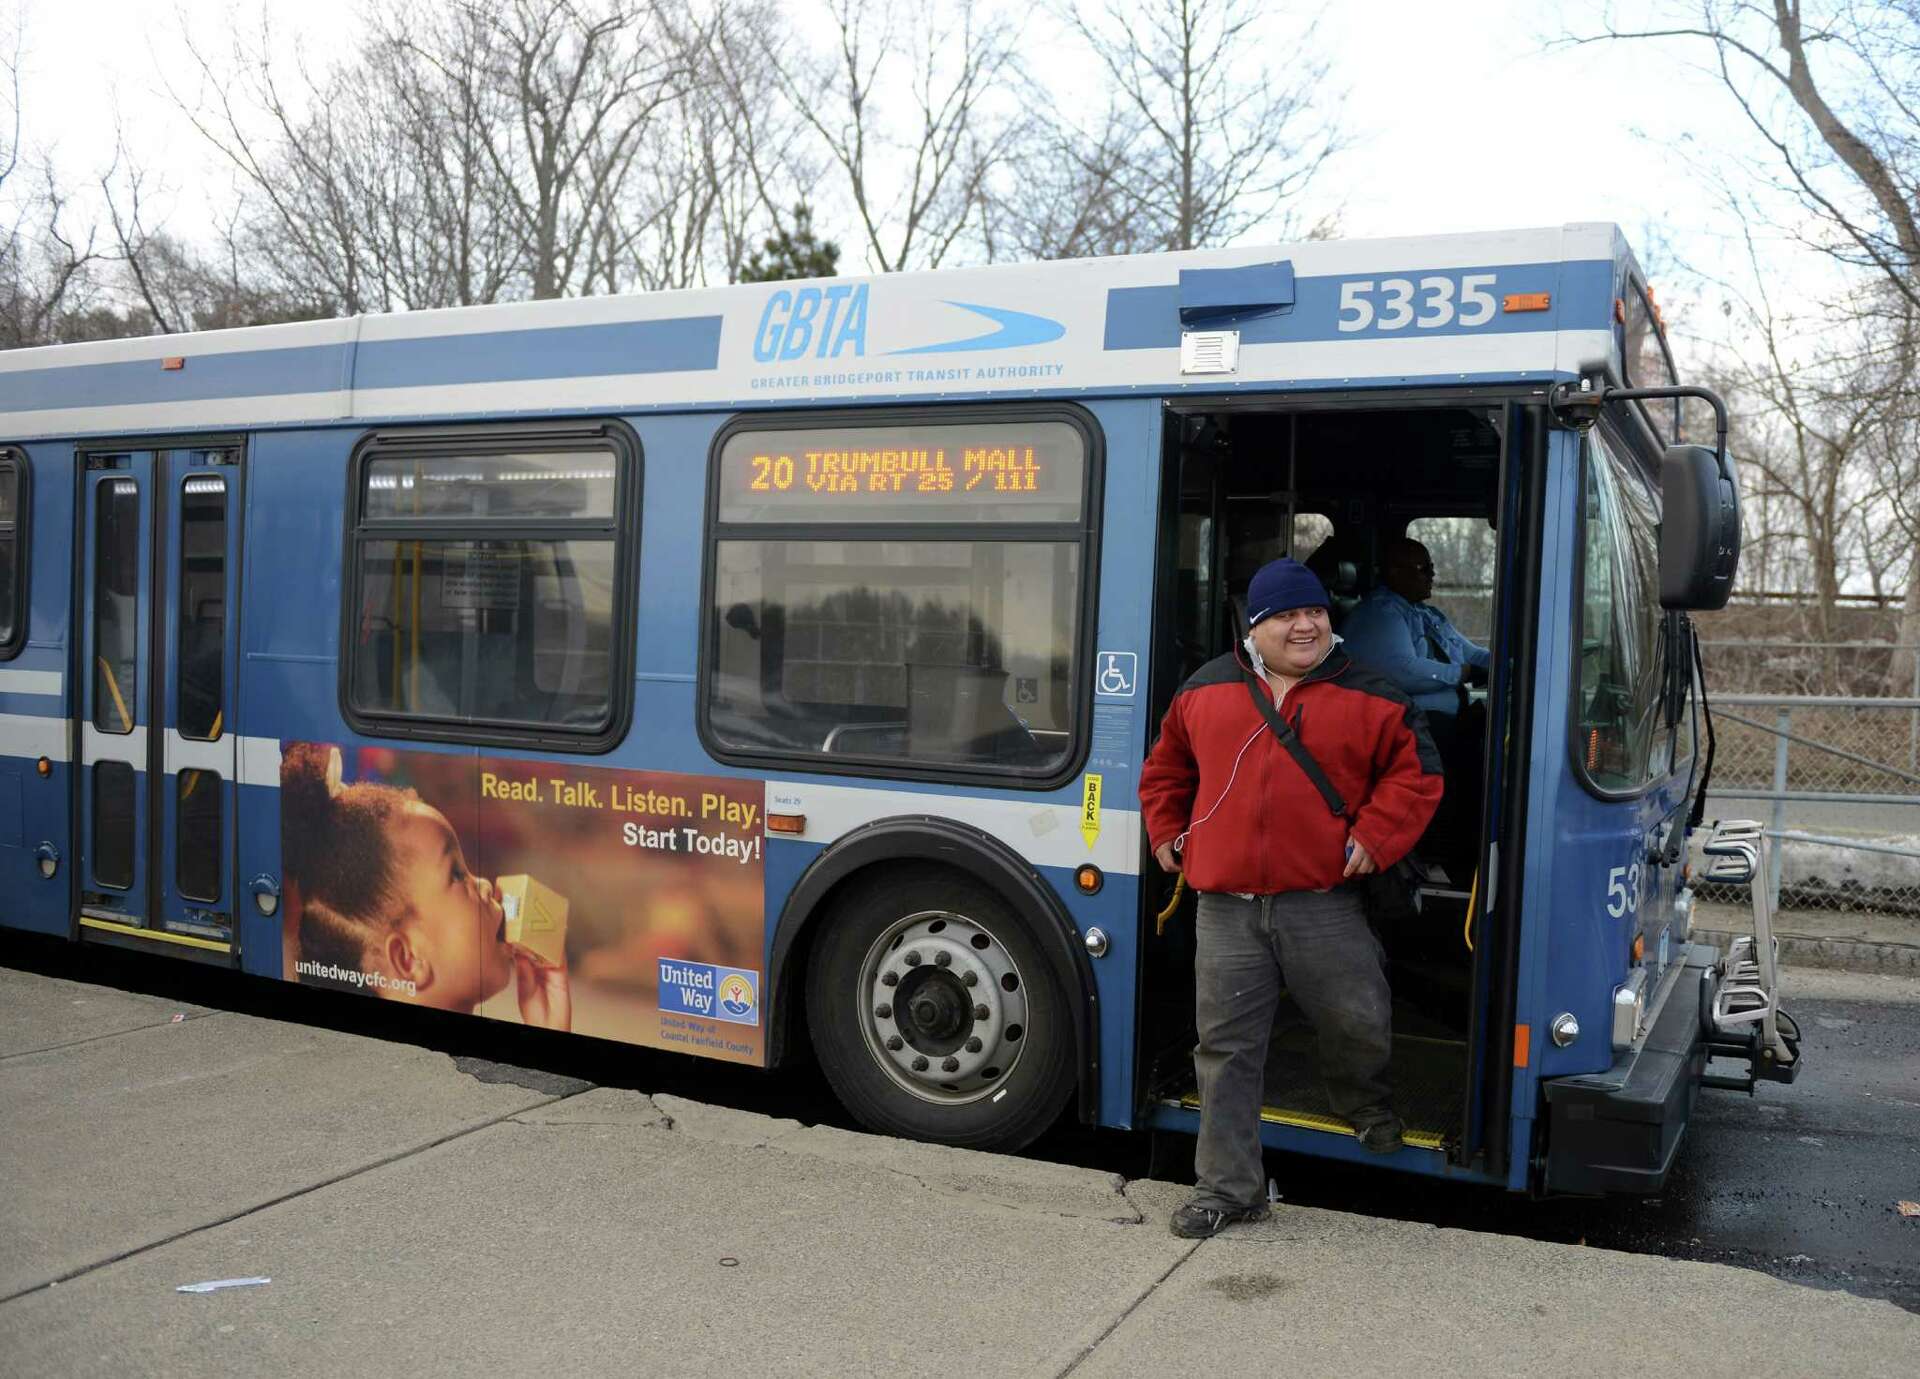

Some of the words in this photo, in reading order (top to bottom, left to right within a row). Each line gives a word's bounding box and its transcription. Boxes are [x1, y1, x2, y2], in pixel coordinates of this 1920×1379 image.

[1338, 274, 1497, 332] 5335
[752, 283, 869, 362] GBTA
[751, 374, 809, 389] GREATER
[814, 371, 901, 386] BRIDGEPORT
[908, 367, 971, 382] TRANSIT
[976, 363, 1064, 379] AUTHORITY
[751, 455, 794, 491] 20
[805, 448, 952, 473] TRUMBULL
[964, 448, 1041, 471] MALL
[805, 473, 857, 492] VIA
[869, 473, 906, 492] RT
[918, 473, 953, 491] 25
[994, 472, 1038, 491] 111
[481, 773, 543, 802] Read.
[550, 780, 603, 808] Talk.
[611, 786, 693, 817] Listen.
[701, 794, 761, 830] Play.
[1086, 783, 1097, 820] BACK
[623, 822, 676, 850] Start
[682, 828, 761, 864] Today!
[1607, 864, 1640, 918] 53
[295, 960, 416, 997] unitedwaycfc.org
[660, 965, 713, 989] United
[680, 987, 713, 1014] Way
[661, 1016, 686, 1029] United
[688, 1022, 705, 1034] Way
[726, 1041, 754, 1056] County
